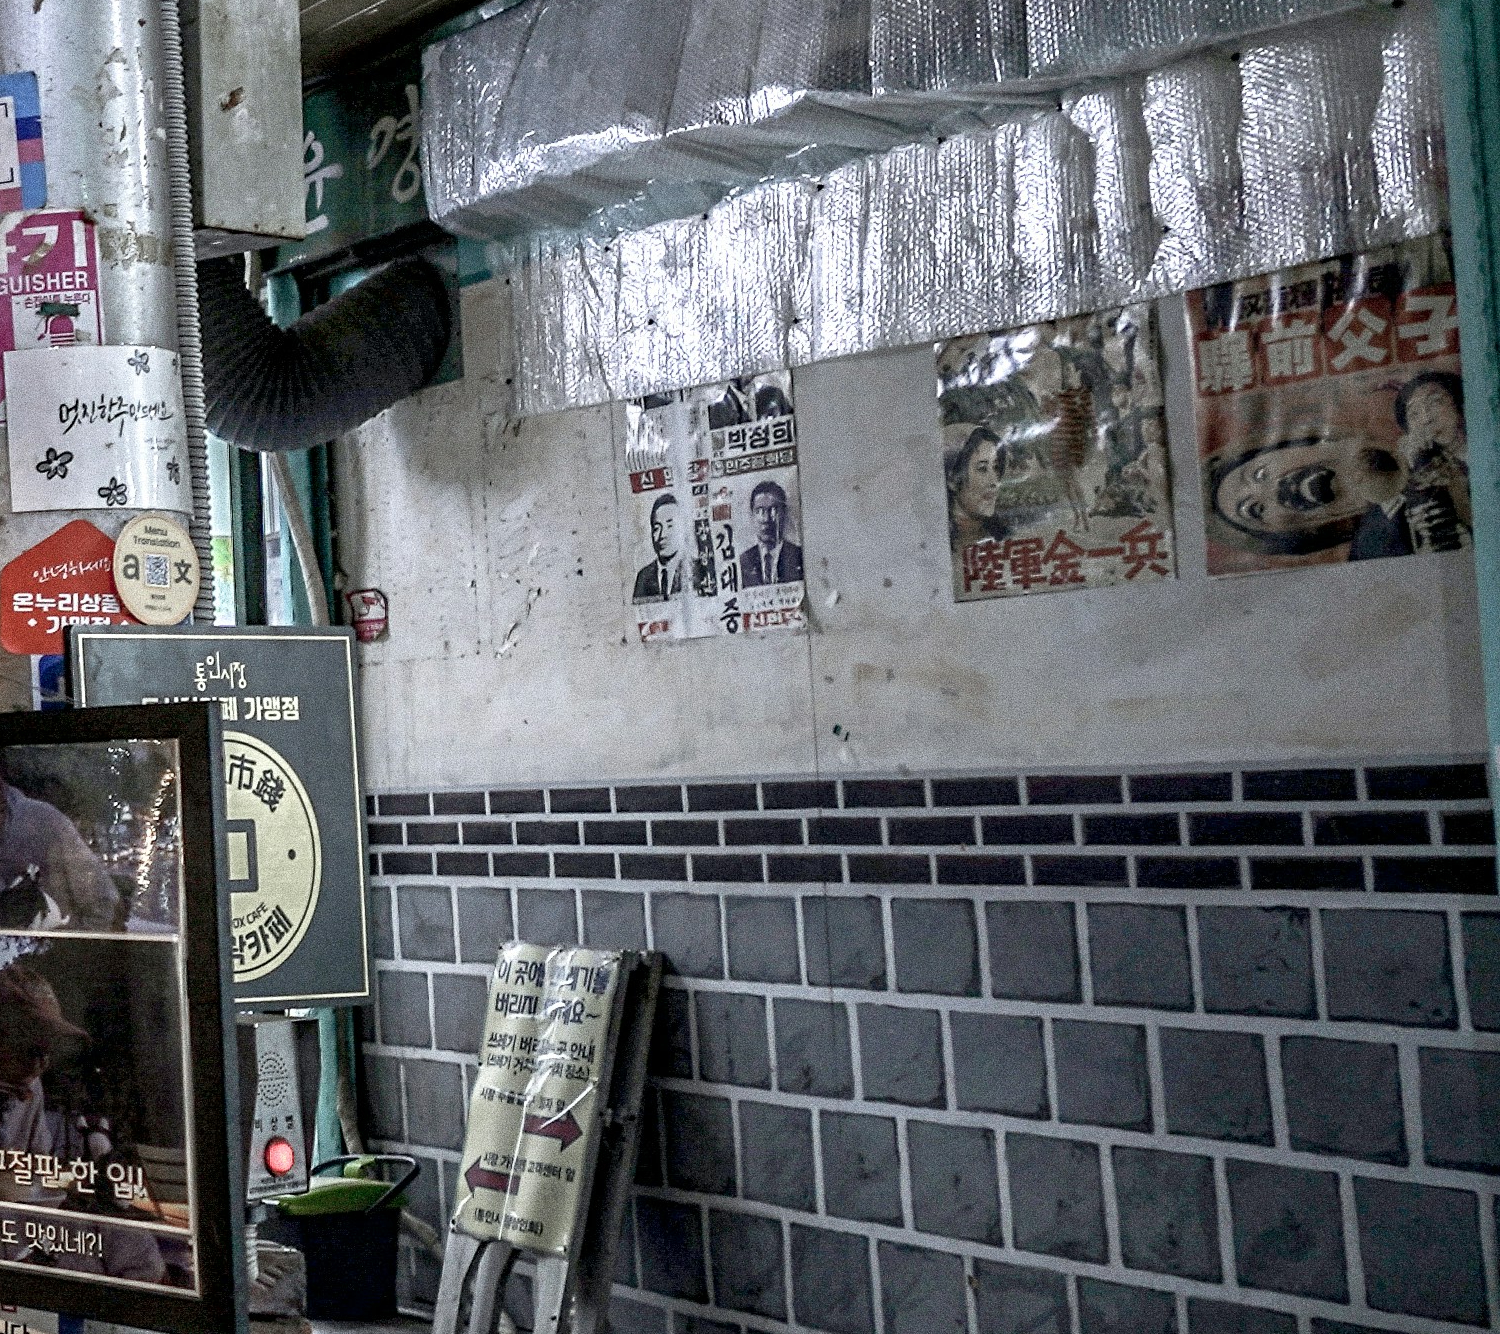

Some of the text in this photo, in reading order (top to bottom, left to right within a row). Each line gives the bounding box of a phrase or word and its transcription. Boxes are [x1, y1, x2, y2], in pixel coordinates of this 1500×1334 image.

[133, 535, 181, 549] Translation
[144, 525, 168, 537] Menu
[715, 523, 742, 634] 김대중
[193, 651, 248, 692] 통인시장
[244, 695, 300, 721] 가맹점
[71, 1156, 99, 1195] 한
[106, 1162, 145, 1200] 입!
[25, 1221, 104, 1259] 맛있네?!
